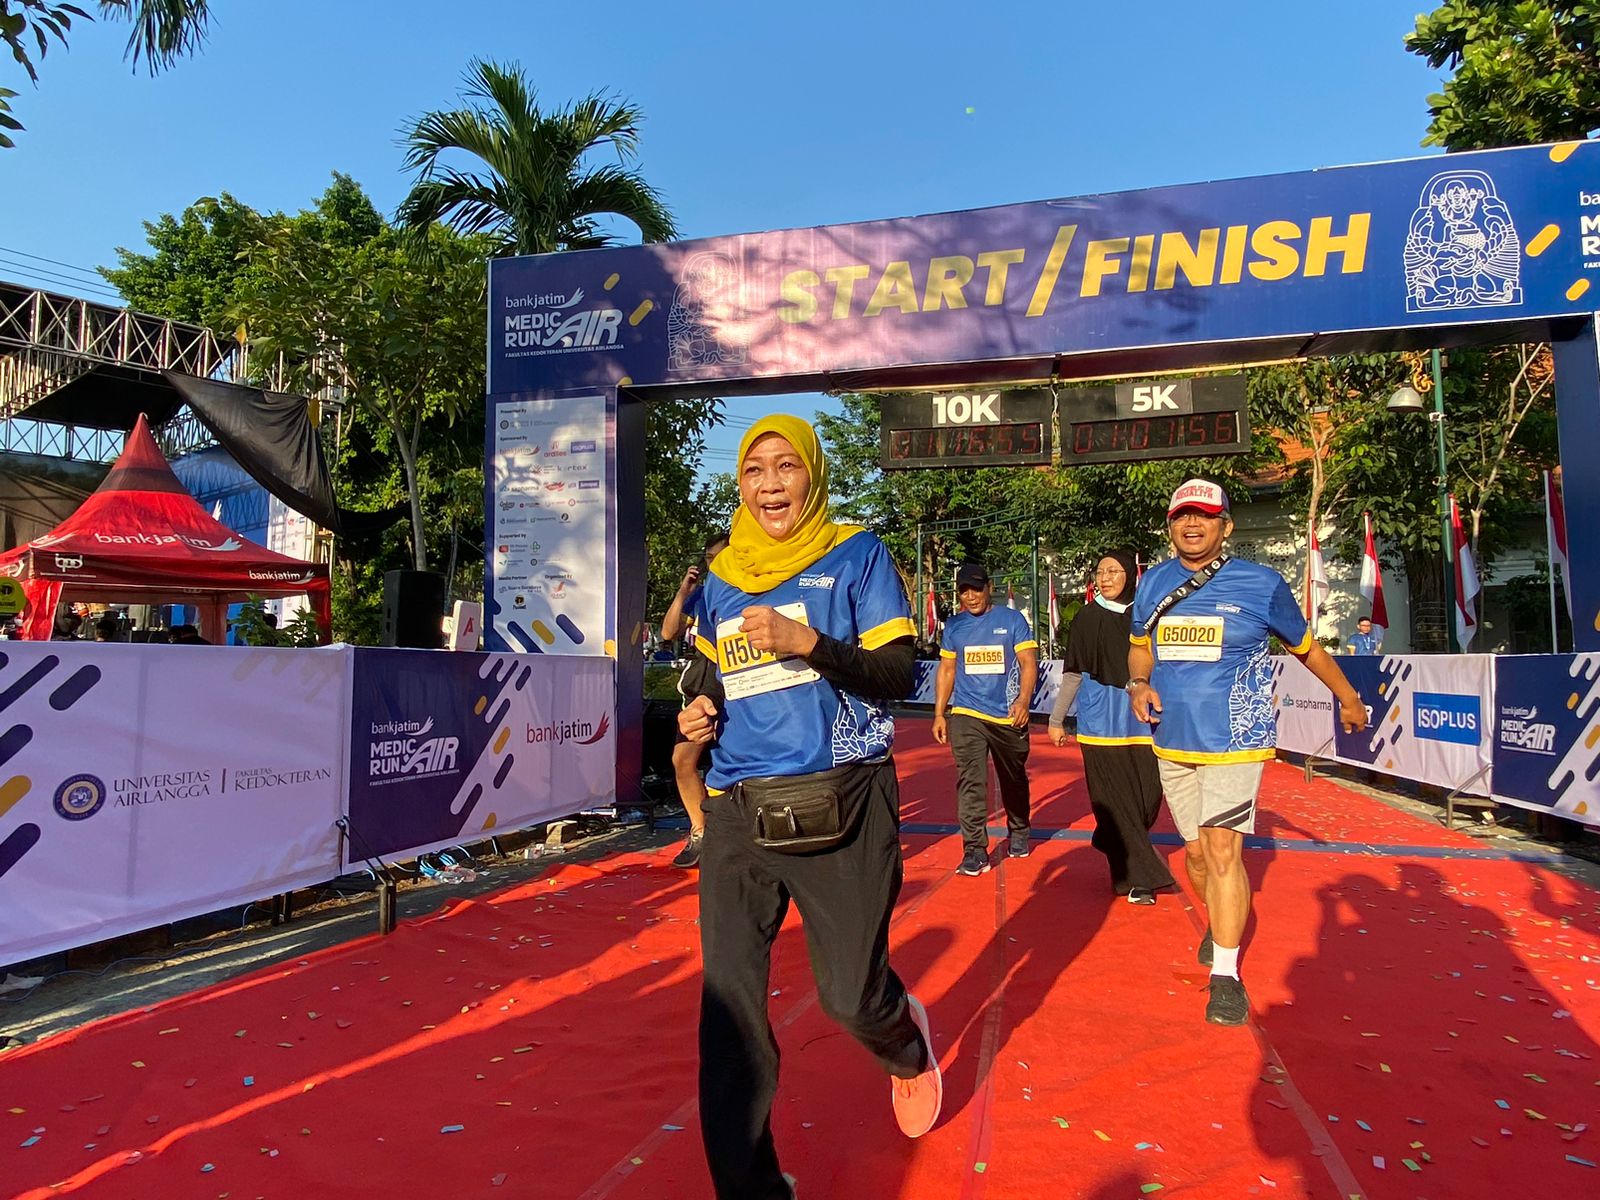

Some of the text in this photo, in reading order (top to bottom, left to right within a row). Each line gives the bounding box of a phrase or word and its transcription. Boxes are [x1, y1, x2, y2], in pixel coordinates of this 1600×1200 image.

[777, 248, 1025, 325] START
[1079, 212, 1372, 298] FINISH
[505, 293, 566, 309] bankjatim
[505, 312, 562, 331] MEDIC
[542, 309, 623, 347] AIR
[505, 330, 541, 348] RUN
[1131, 384, 1179, 412] 5K
[932, 394, 1000, 425] 10K
[95, 533, 212, 548] bankjatim
[248, 569, 301, 581] bankjatim
[1163, 626, 1216, 643] G50020
[371, 720, 420, 736] bankjatim
[1417, 708, 1476, 730] ISOPLUS
[1501, 719, 1527, 732] MEDIC
[526, 718, 592, 745] bankjatim
[1501, 731, 1518, 743] RUN
[1517, 723, 1556, 751] AIR
[370, 738, 417, 759] MEDIC
[400, 736, 460, 774] AIR
[235, 767, 273, 778] FAKULTAS
[370, 757, 400, 776] RUN
[113, 769, 211, 794] UNIVERSITAS
[234, 768, 332, 791] KEDOKTERAN
[113, 784, 211, 808] AIRLANGGA
